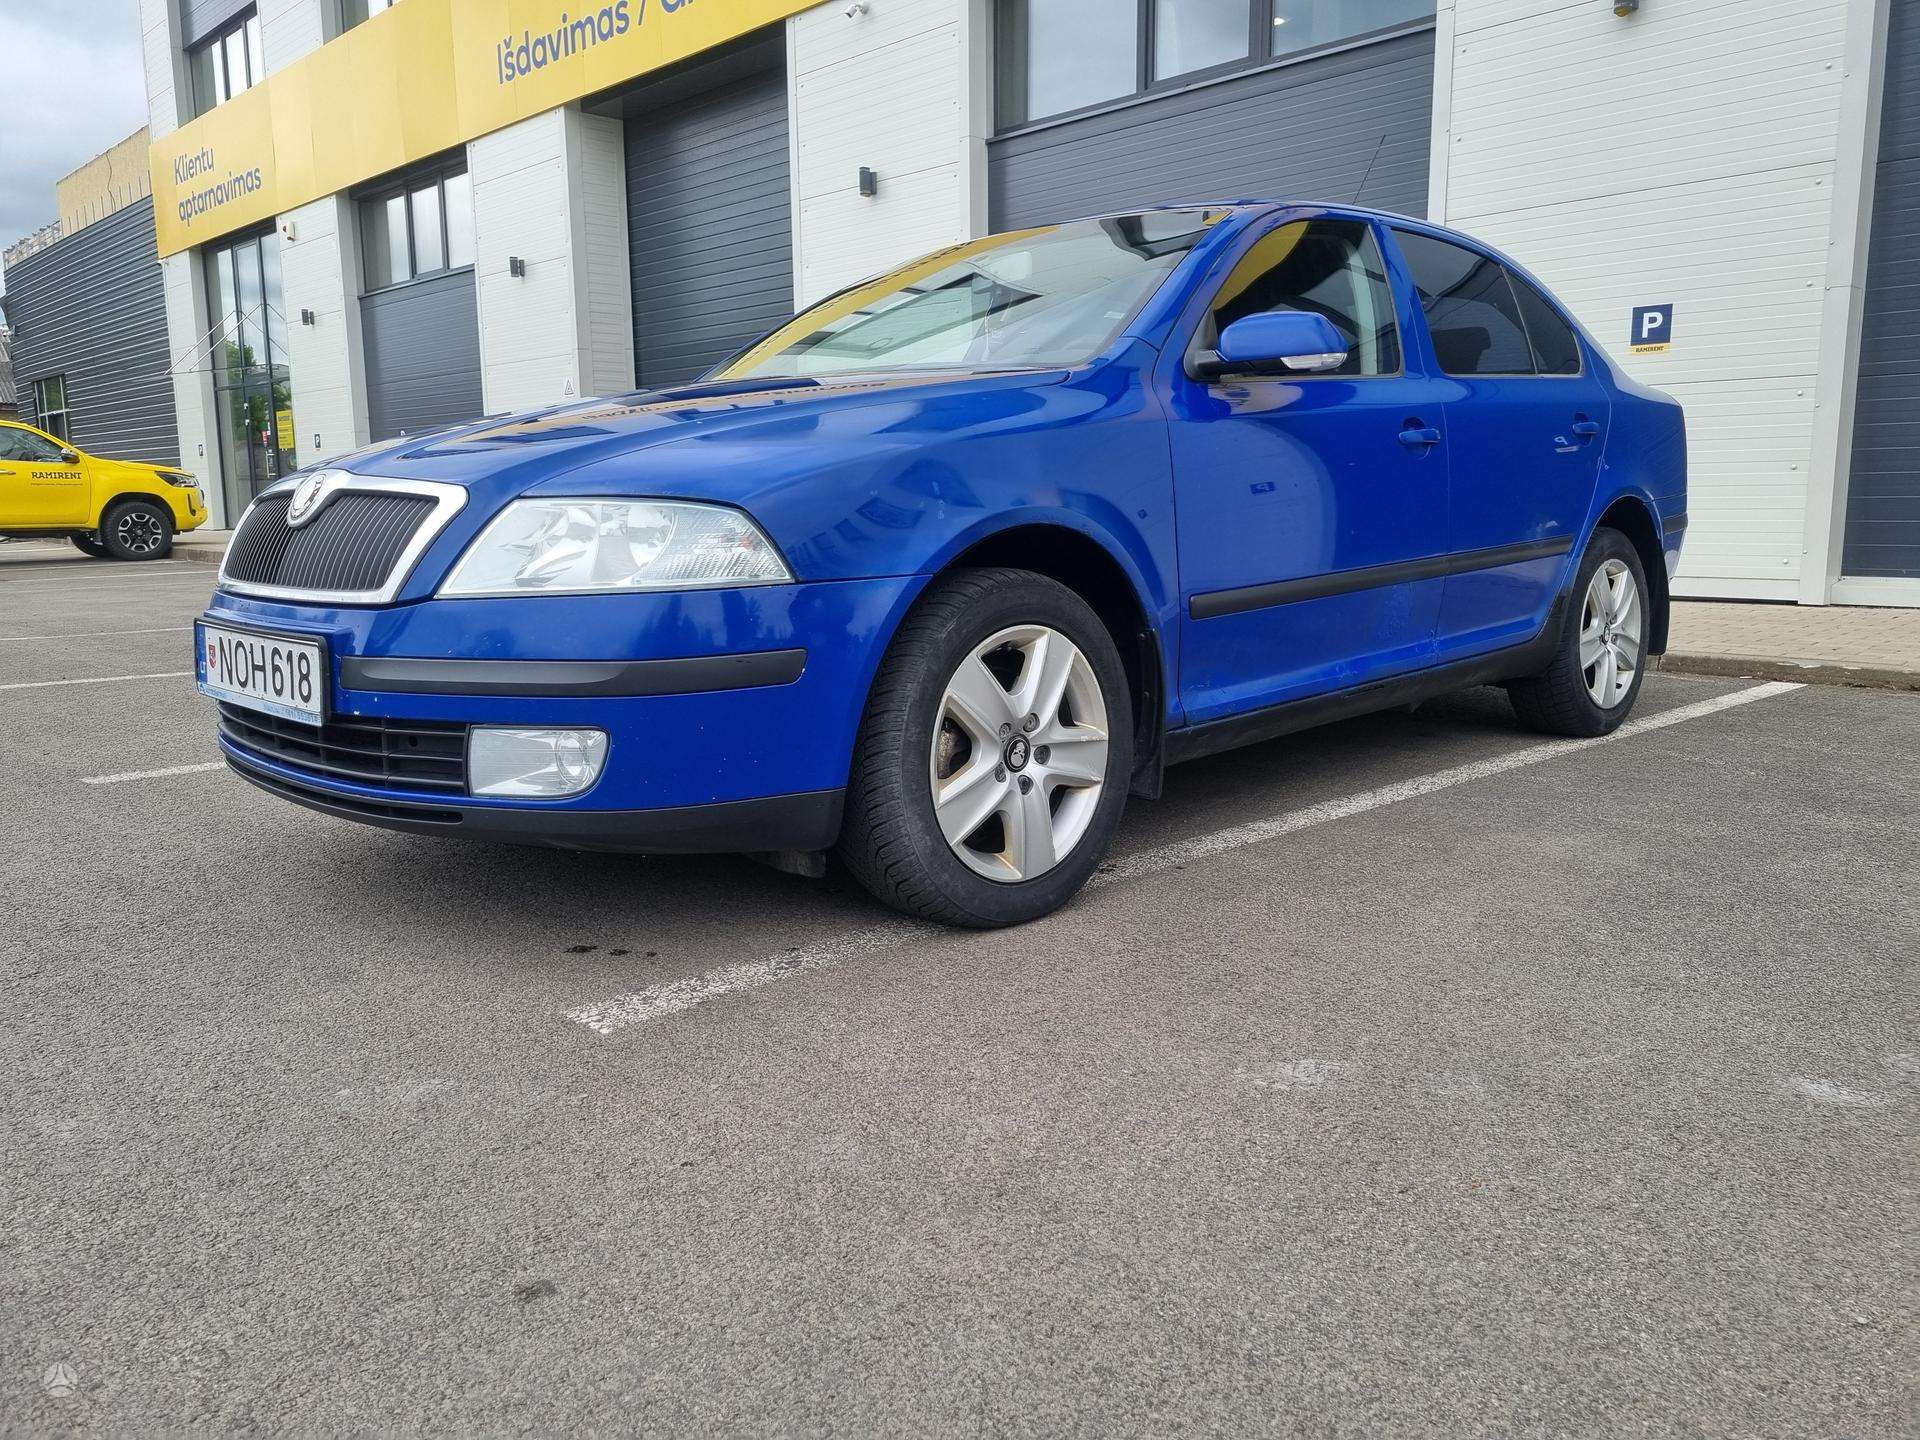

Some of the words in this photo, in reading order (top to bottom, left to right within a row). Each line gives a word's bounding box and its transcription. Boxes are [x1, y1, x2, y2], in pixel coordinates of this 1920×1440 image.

[497, 0, 629, 84] Išdavimas
[178, 167, 262, 227] aptarnavimas
[1642, 312, 1663, 338] P
[1635, 345, 1665, 353] RAMIRENT
[31, 471, 82, 479] RAMIRENT
[218, 636, 312, 703] NOH618
